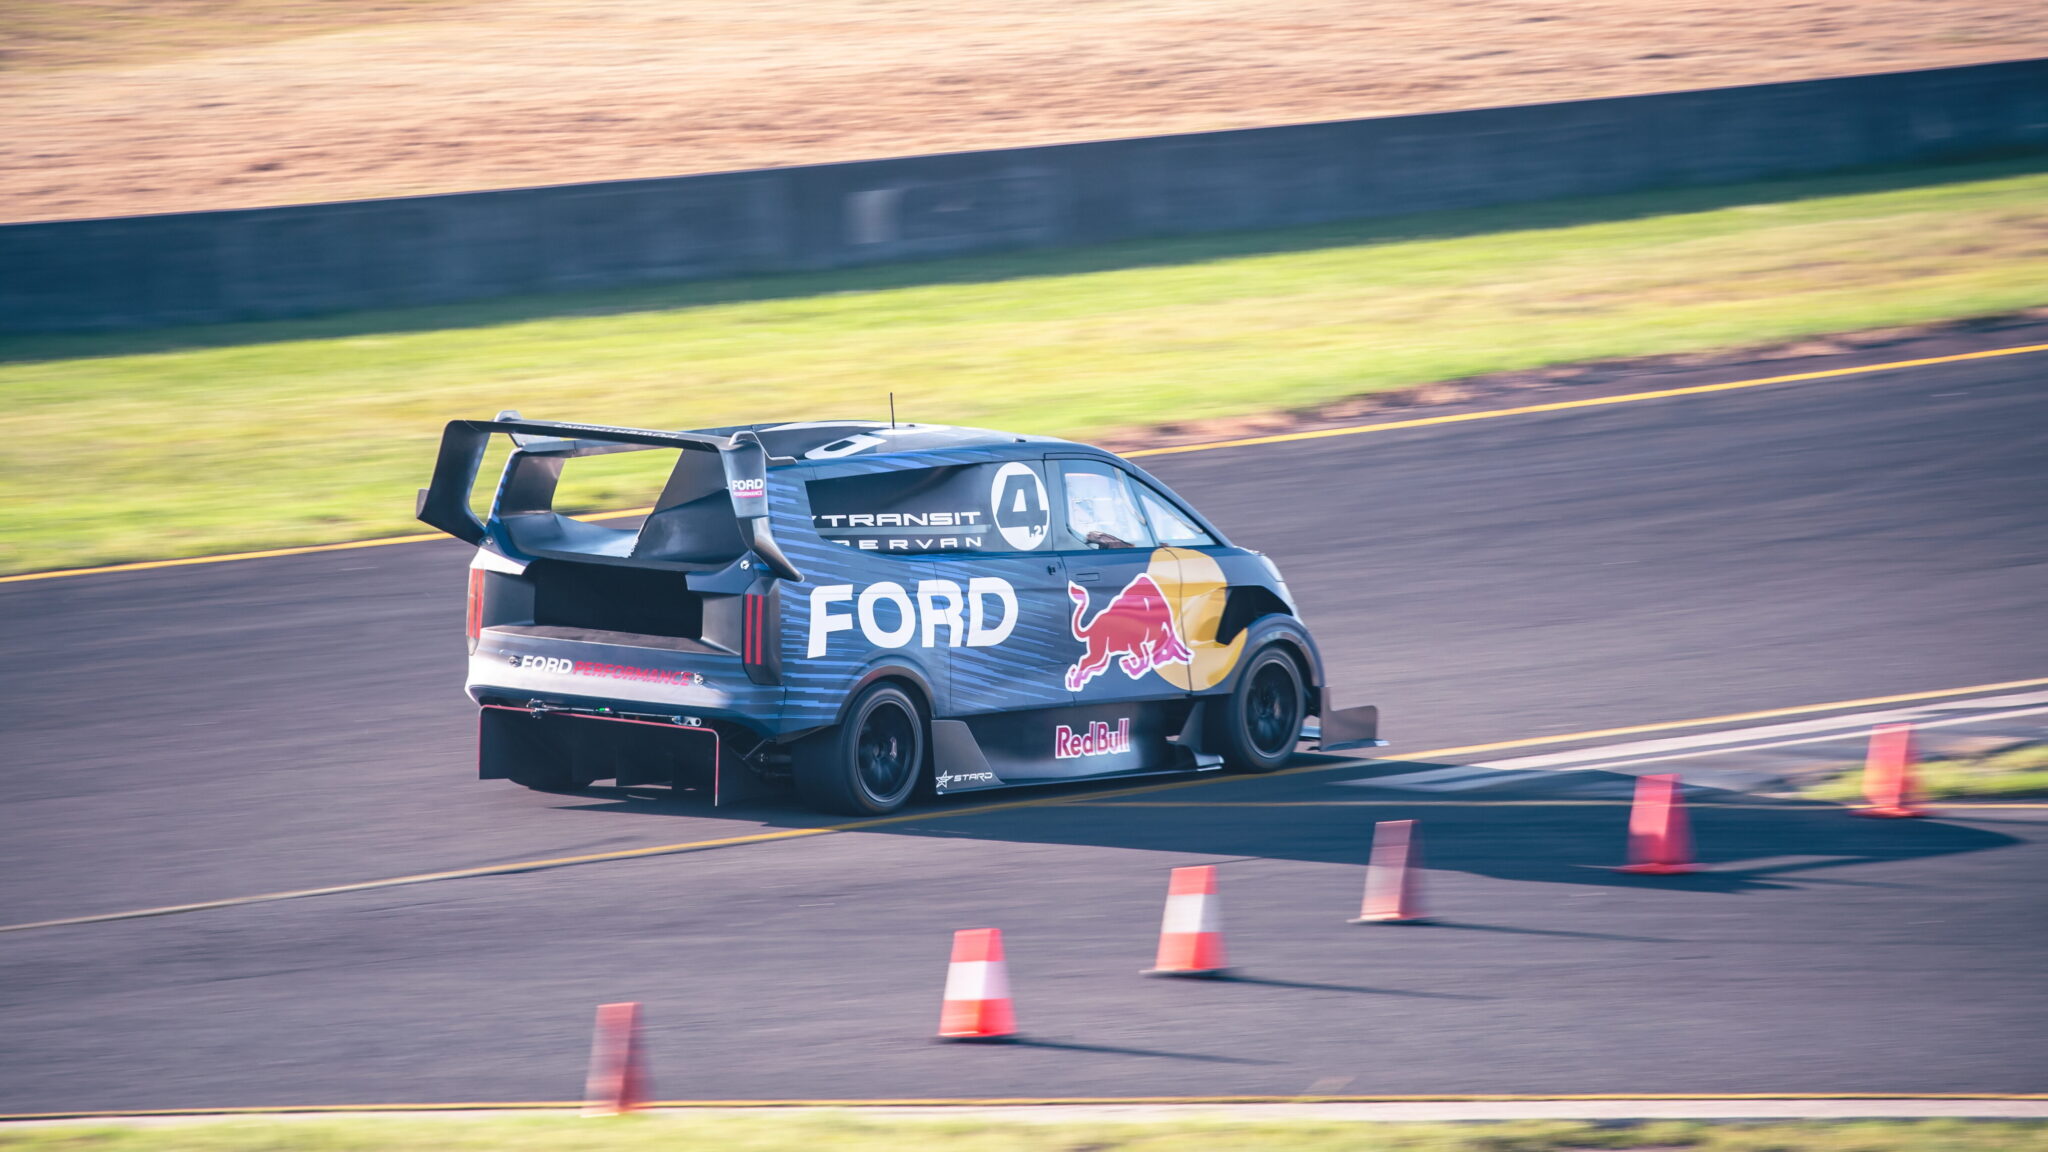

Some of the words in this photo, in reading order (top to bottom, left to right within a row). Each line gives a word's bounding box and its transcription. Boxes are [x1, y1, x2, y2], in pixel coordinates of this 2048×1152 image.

[732, 478, 764, 491] FORD
[821, 511, 981, 527] TRANSIT
[807, 576, 1019, 659] FORD
[520, 655, 573, 674] FORD
[572, 660, 692, 686] PERFORMANCE
[954, 771, 993, 783] STARD
